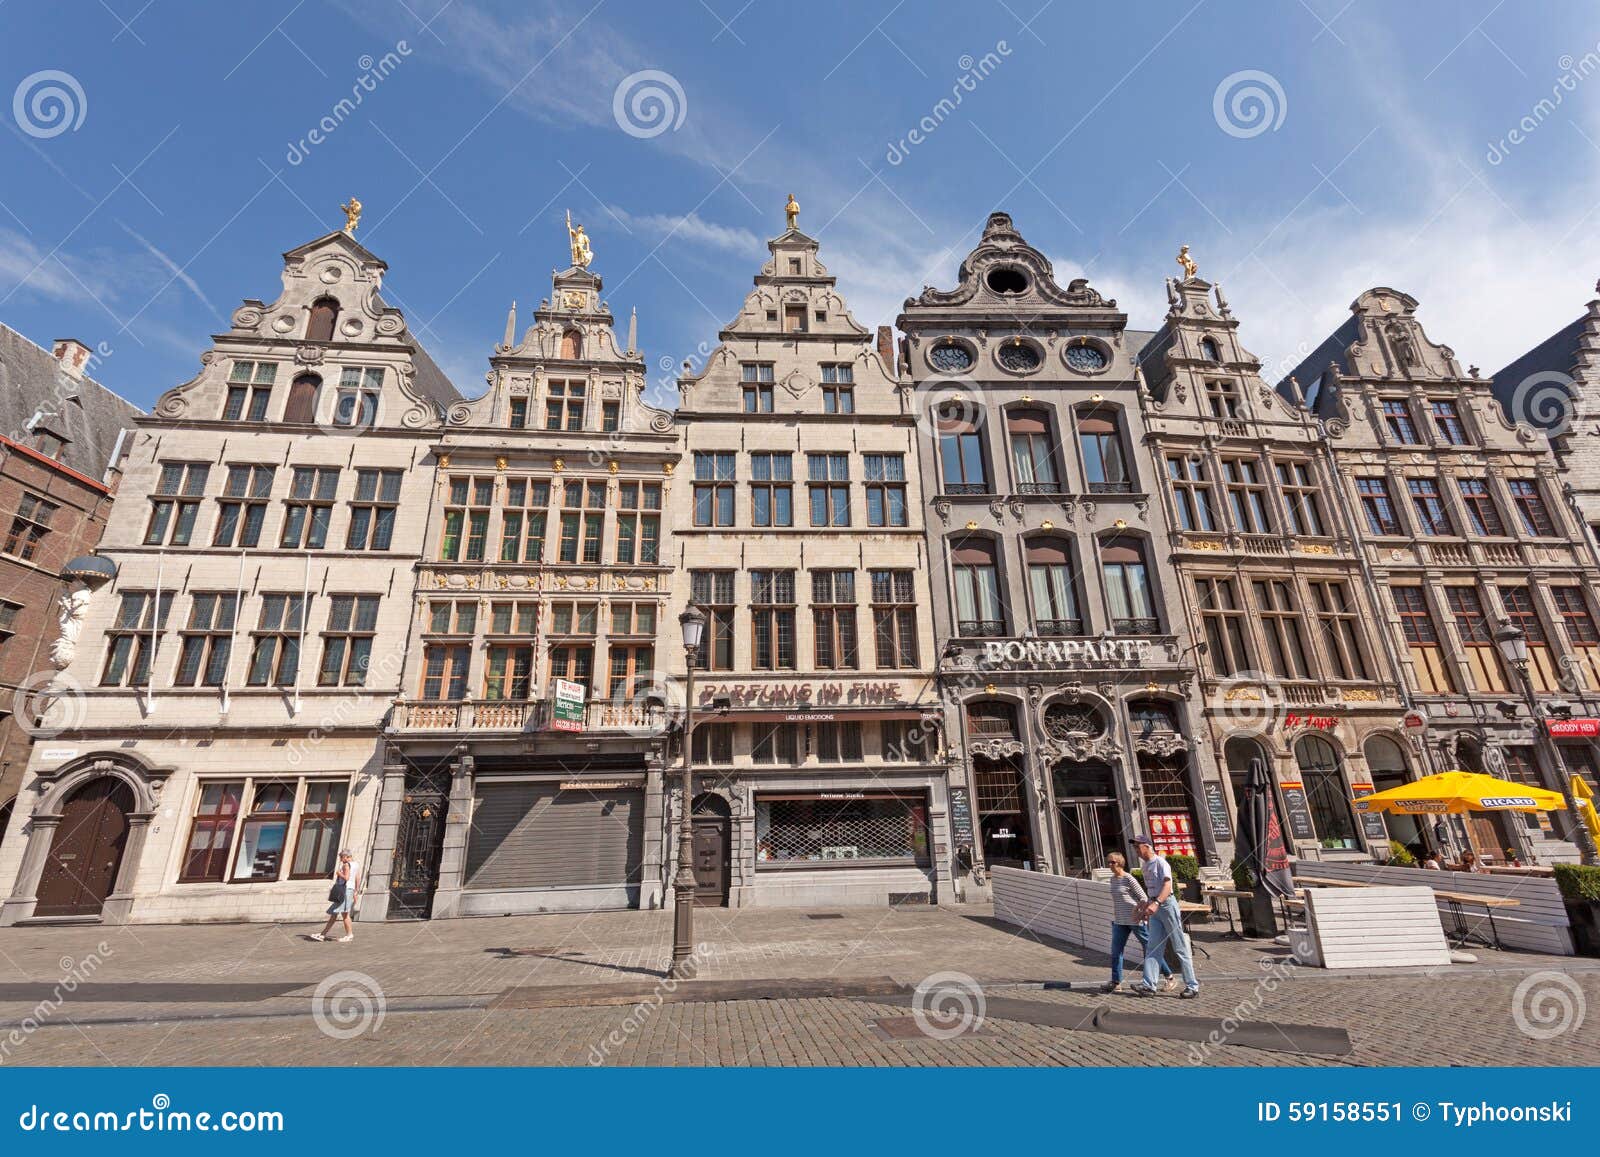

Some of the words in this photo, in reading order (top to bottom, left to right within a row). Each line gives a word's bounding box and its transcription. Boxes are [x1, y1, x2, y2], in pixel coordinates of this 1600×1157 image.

[984, 640, 1151, 662] BONAPARTE
[704, 682, 812, 700] PARFUMS
[822, 682, 843, 698] IN
[853, 682, 902, 699] FINE
[1551, 723, 1578, 733] BROODY
[1580, 723, 1596, 732] HEN
[1481, 798, 1535, 807] RICARD
